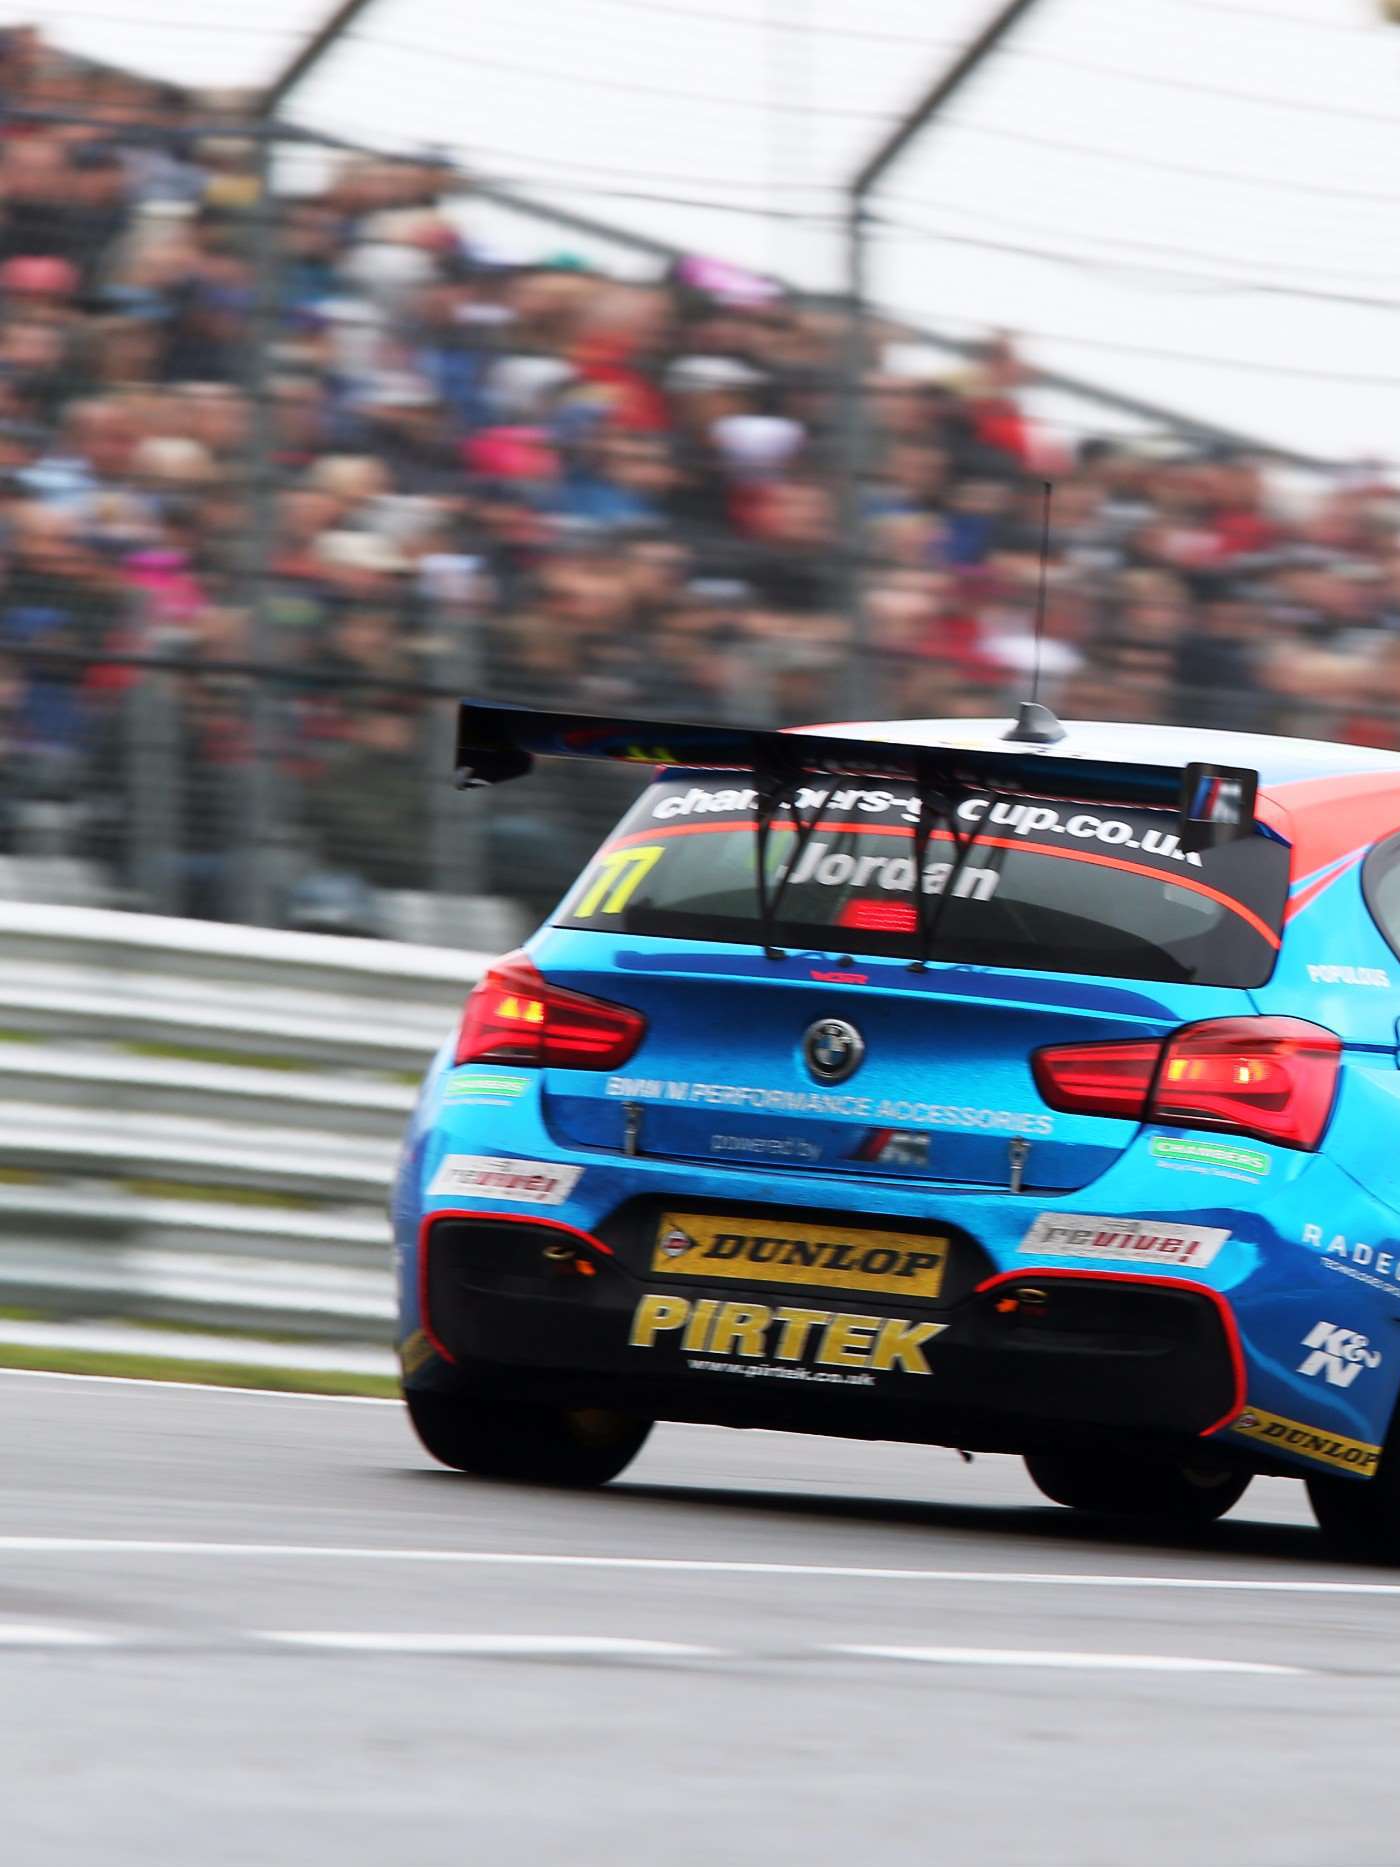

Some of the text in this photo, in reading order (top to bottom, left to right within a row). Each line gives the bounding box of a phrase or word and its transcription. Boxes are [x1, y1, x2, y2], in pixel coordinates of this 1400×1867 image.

[572, 846, 667, 918] 77
[775, 842, 999, 901] Jordan
[606, 1075, 662, 1099] BMW
[691, 1083, 872, 1117] PERFORMANCE
[875, 1100, 1055, 1135] ACCESSORIES
[1156, 1142, 1265, 1169] CHAMBERS
[702, 1233, 941, 1278] DUNLOP
[628, 1293, 951, 1376] PIRTEK
[688, 1358, 877, 1387] www.pirtek.co.uk
[1260, 1421, 1381, 1468] DUNLOP
